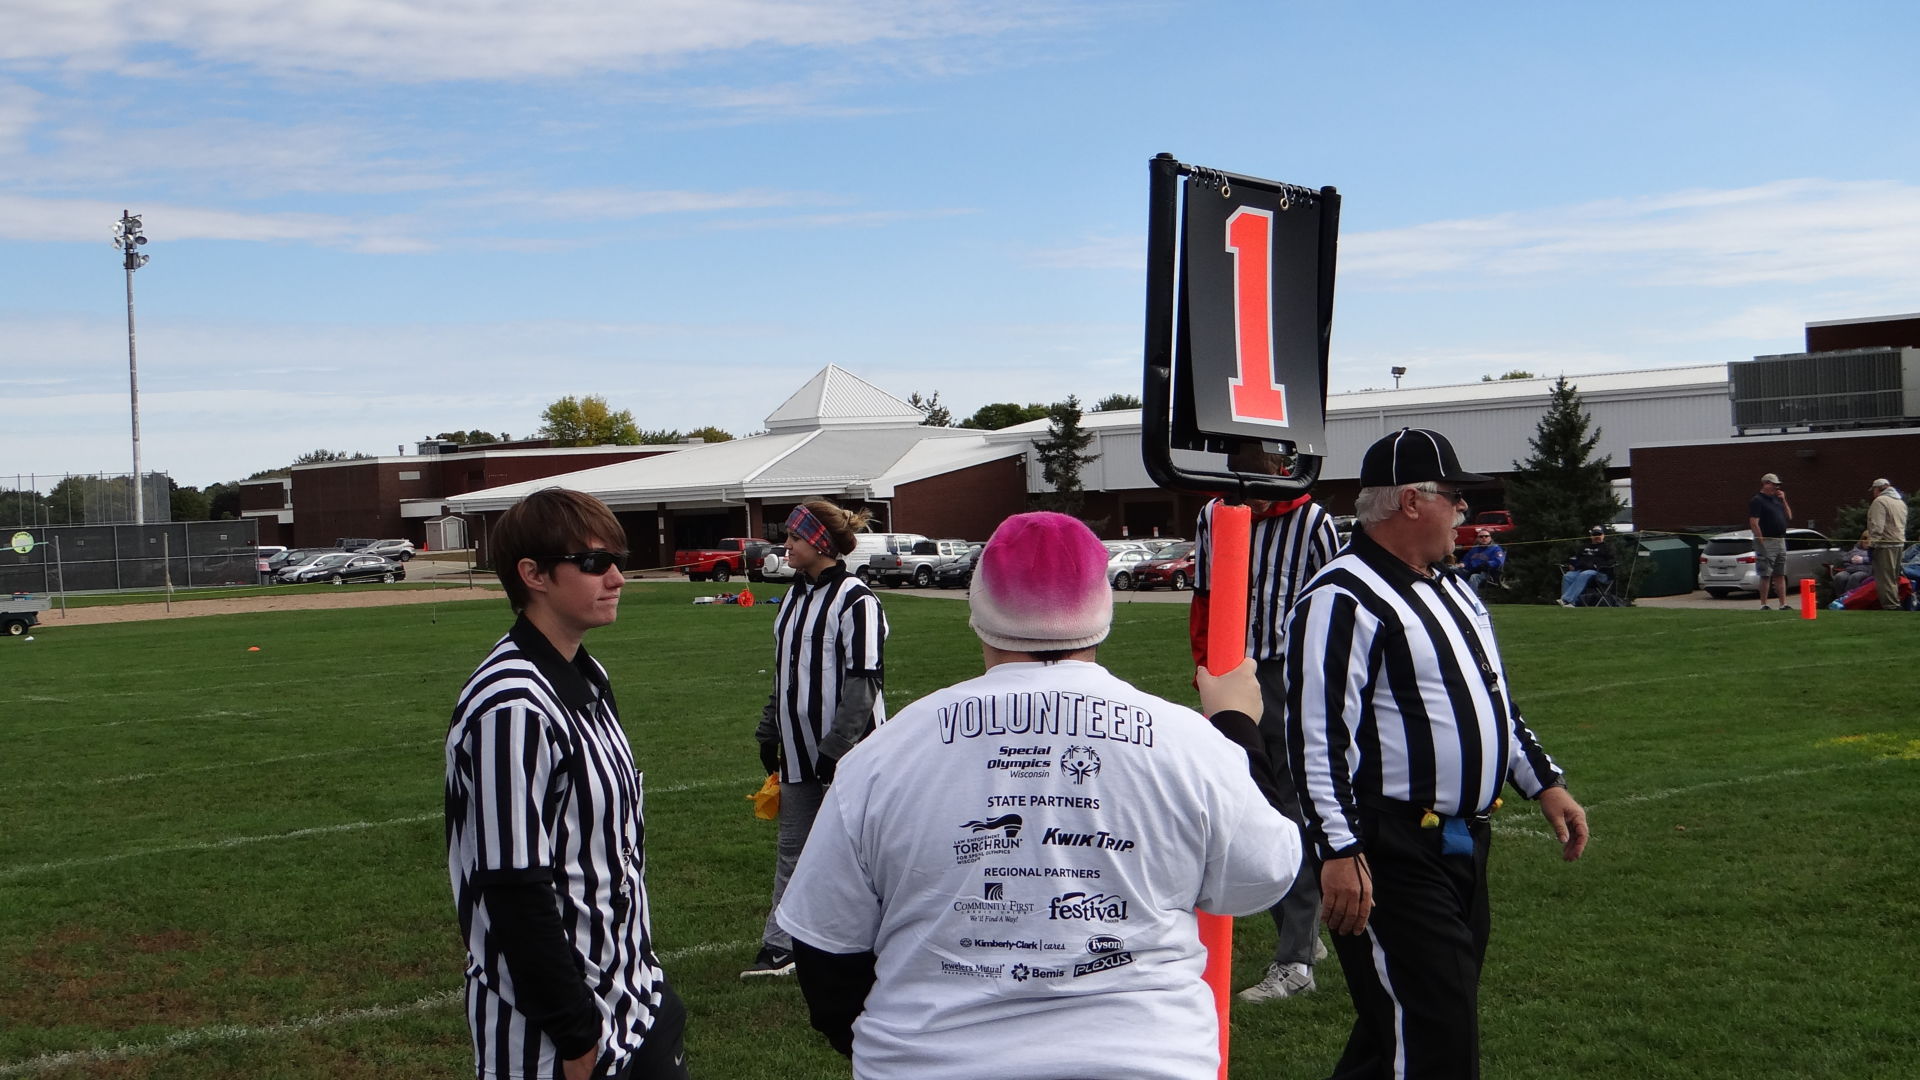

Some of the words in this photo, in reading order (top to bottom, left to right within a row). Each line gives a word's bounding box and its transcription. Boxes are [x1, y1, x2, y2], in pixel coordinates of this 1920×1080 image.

[1224, 205, 1289, 428] 1
[937, 691, 1154, 747] VOLUNTEER
[999, 745, 1052, 757] Special
[987, 758, 1052, 770] Olympics
[1010, 770, 1050, 778] Wisconsin
[987, 795, 1027, 808] STATE
[1030, 795, 1100, 810] PARTNERS
[1042, 827, 1095, 847] KWIK
[1096, 831, 1135, 852] TRIP
[984, 867, 1042, 877] REGIONAL
[1044, 868, 1101, 879] PARTNERS
[953, 901, 1007, 912] COMMUNITY
[1009, 900, 1034, 912] FIRST
[1047, 897, 1128, 921] festival
[984, 915, 999, 923] Find
[1091, 939, 1121, 952] Tyson
[941, 960, 973, 972] Jewelers
[975, 964, 1002, 974] Mutual
[1075, 952, 1131, 976] PLEXUS
[1032, 968, 1065, 978] Bemis
